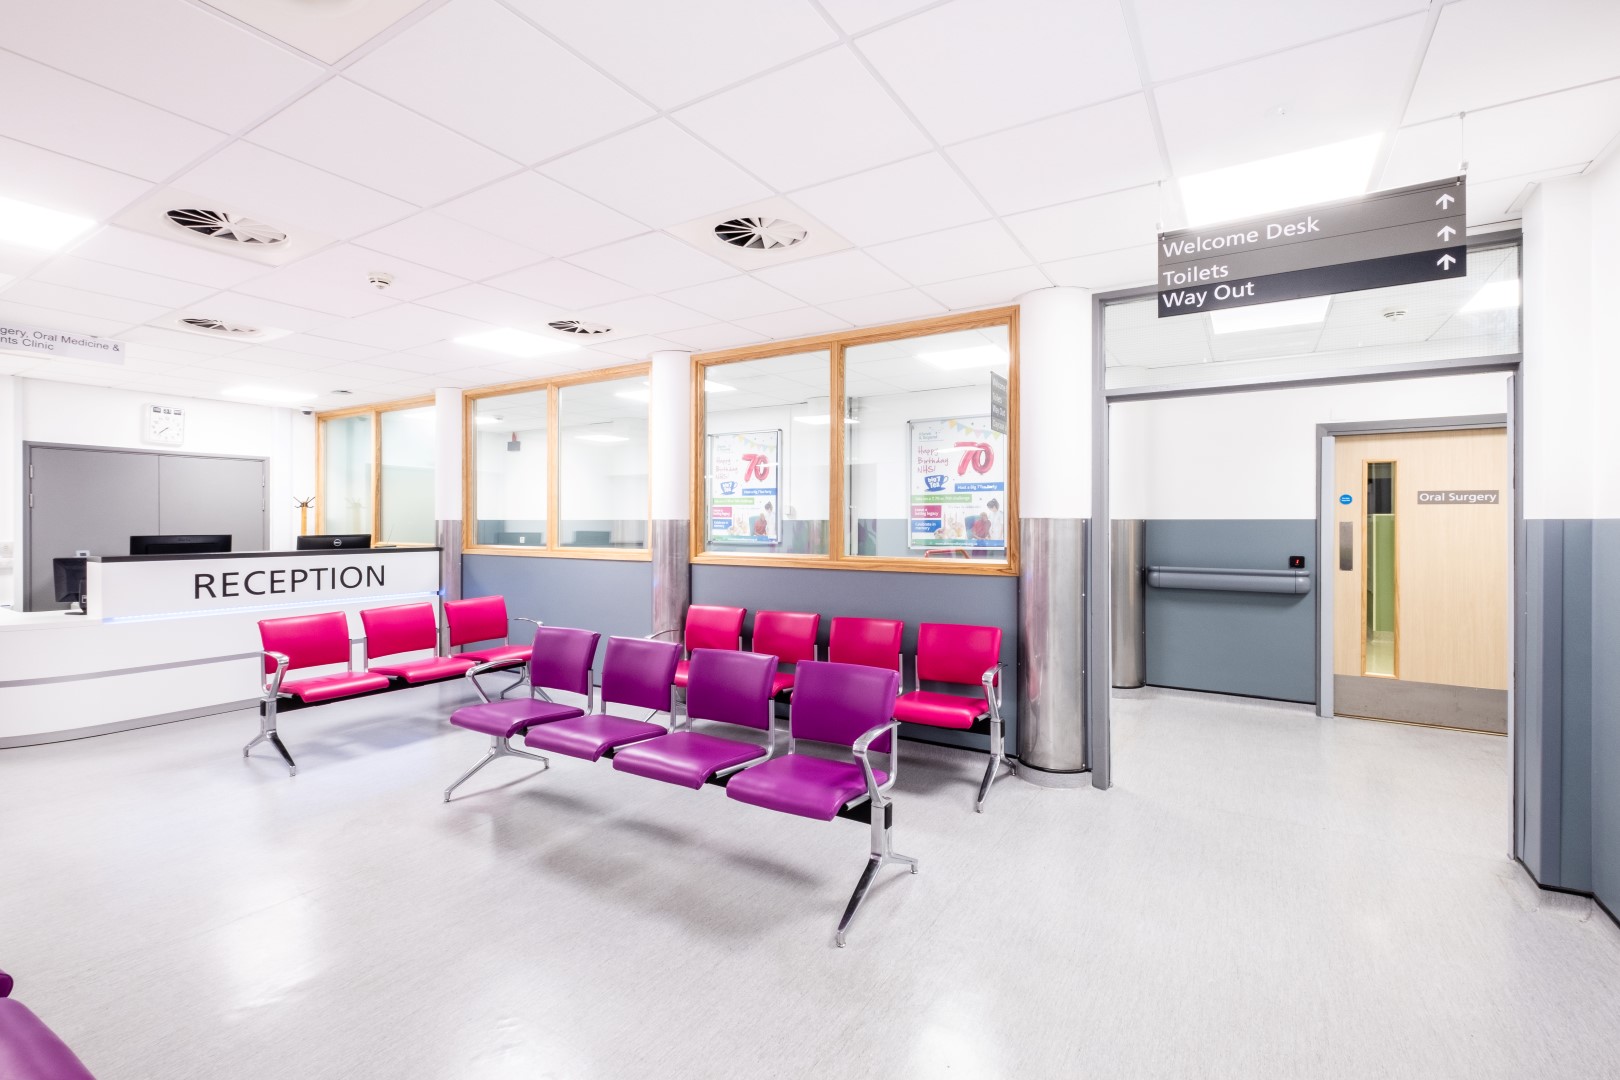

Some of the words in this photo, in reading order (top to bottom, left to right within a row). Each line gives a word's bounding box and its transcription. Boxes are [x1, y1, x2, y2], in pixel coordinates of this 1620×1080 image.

[1162, 230, 1258, 258] Welcome
[1266, 216, 1320, 240] Desk
[1162, 263, 1229, 286] Toilets
[1162, 289, 1207, 309] Way
[1213, 281, 1255, 301] Out
[22, 338, 54, 351] Clinic
[33, 331, 57, 342] Oral
[61, 335, 109, 350] Medicine
[742, 454, 769, 482] 70
[918, 456, 949, 467] Birthday
[953, 441, 994, 476] 70
[1419, 492, 1445, 501] Oral
[1448, 492, 1497, 503] Surgery
[194, 565, 385, 599] RECEPTION
